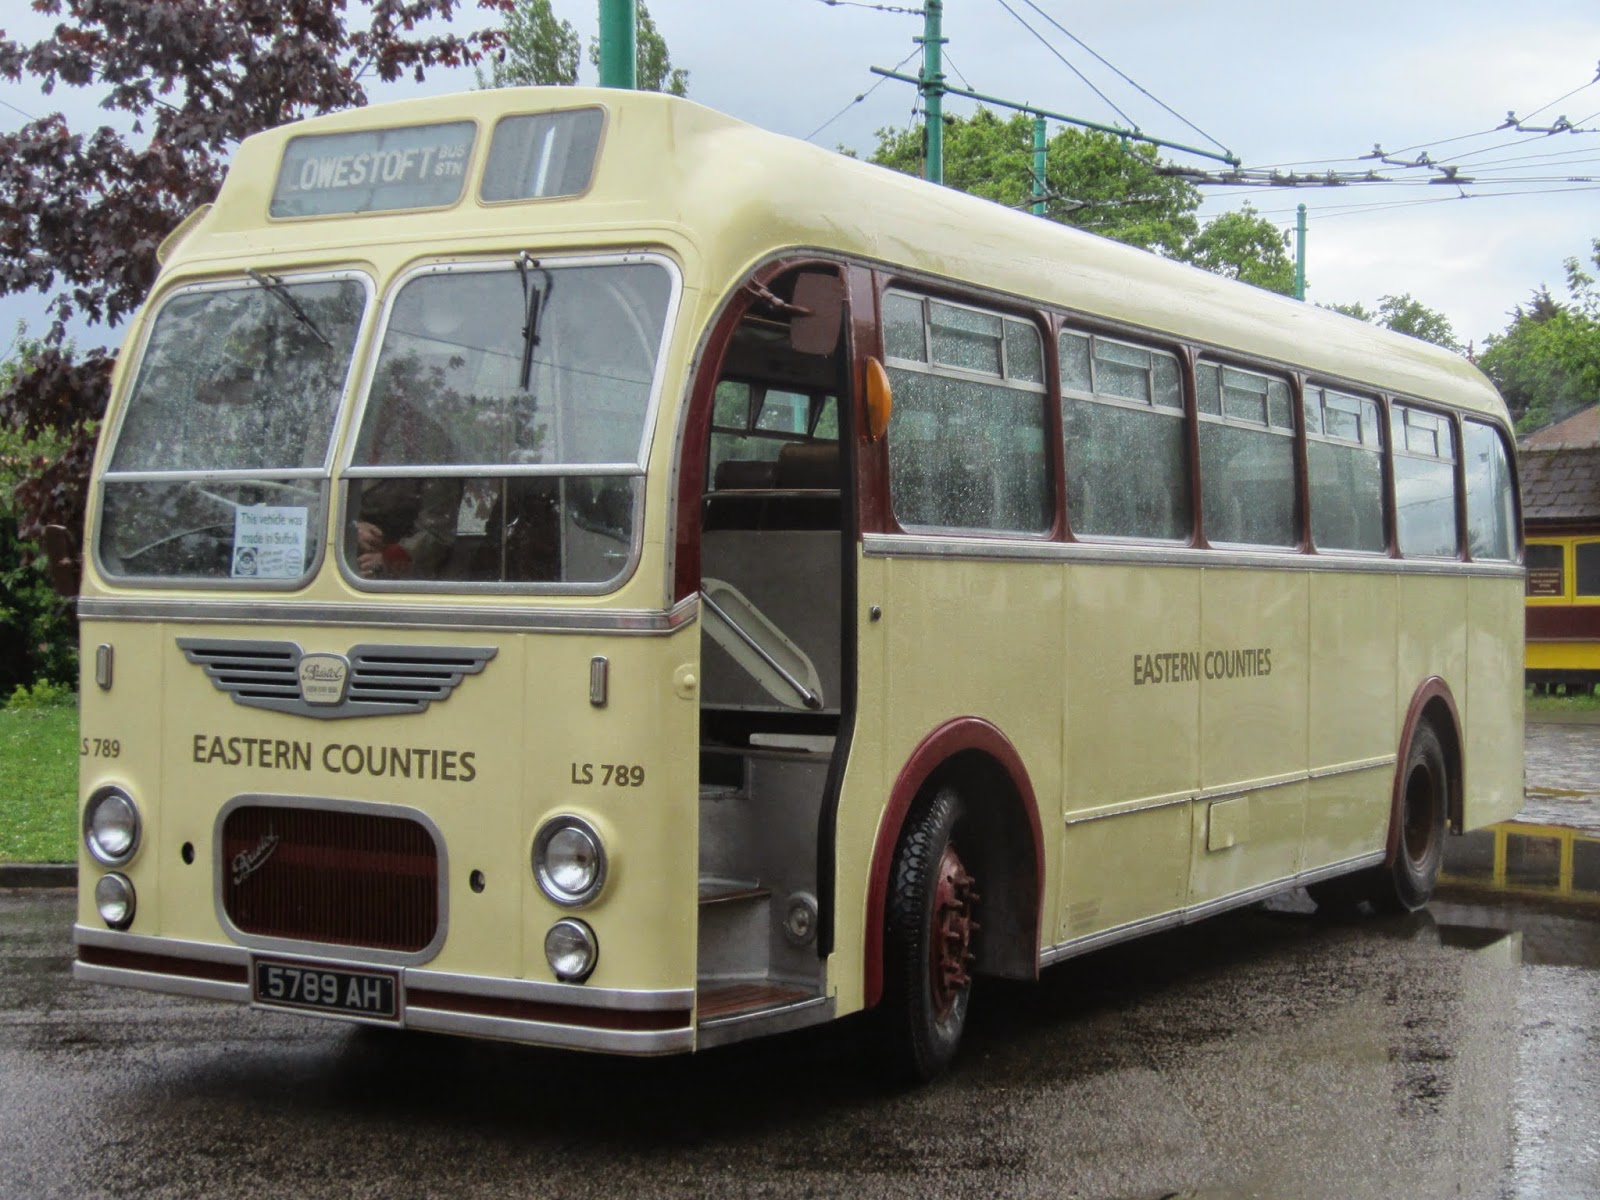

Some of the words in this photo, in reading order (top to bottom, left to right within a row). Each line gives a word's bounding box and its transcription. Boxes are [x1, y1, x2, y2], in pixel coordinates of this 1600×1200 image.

[439, 144, 465, 159] BUS
[435, 161, 463, 177] STN
[240, 512, 257, 525] This
[260, 514, 286, 526] vehicle
[289, 517, 303, 526] was
[241, 532, 263, 544] made
[265, 532, 273, 544] in
[301, 664, 343, 682] Bristol
[1133, 652, 1200, 685] EASTERN
[1204, 648, 1272, 680] COUNTIES
[80, 737, 89, 756] S
[93, 738, 121, 758] 789
[193, 735, 312, 771] EASTERN
[322, 744, 477, 782] COUNTIES
[571, 762, 594, 785] LS
[600, 764, 645, 787] 789
[267, 967, 338, 1004] 5789
[345, 976, 381, 1010] AH
